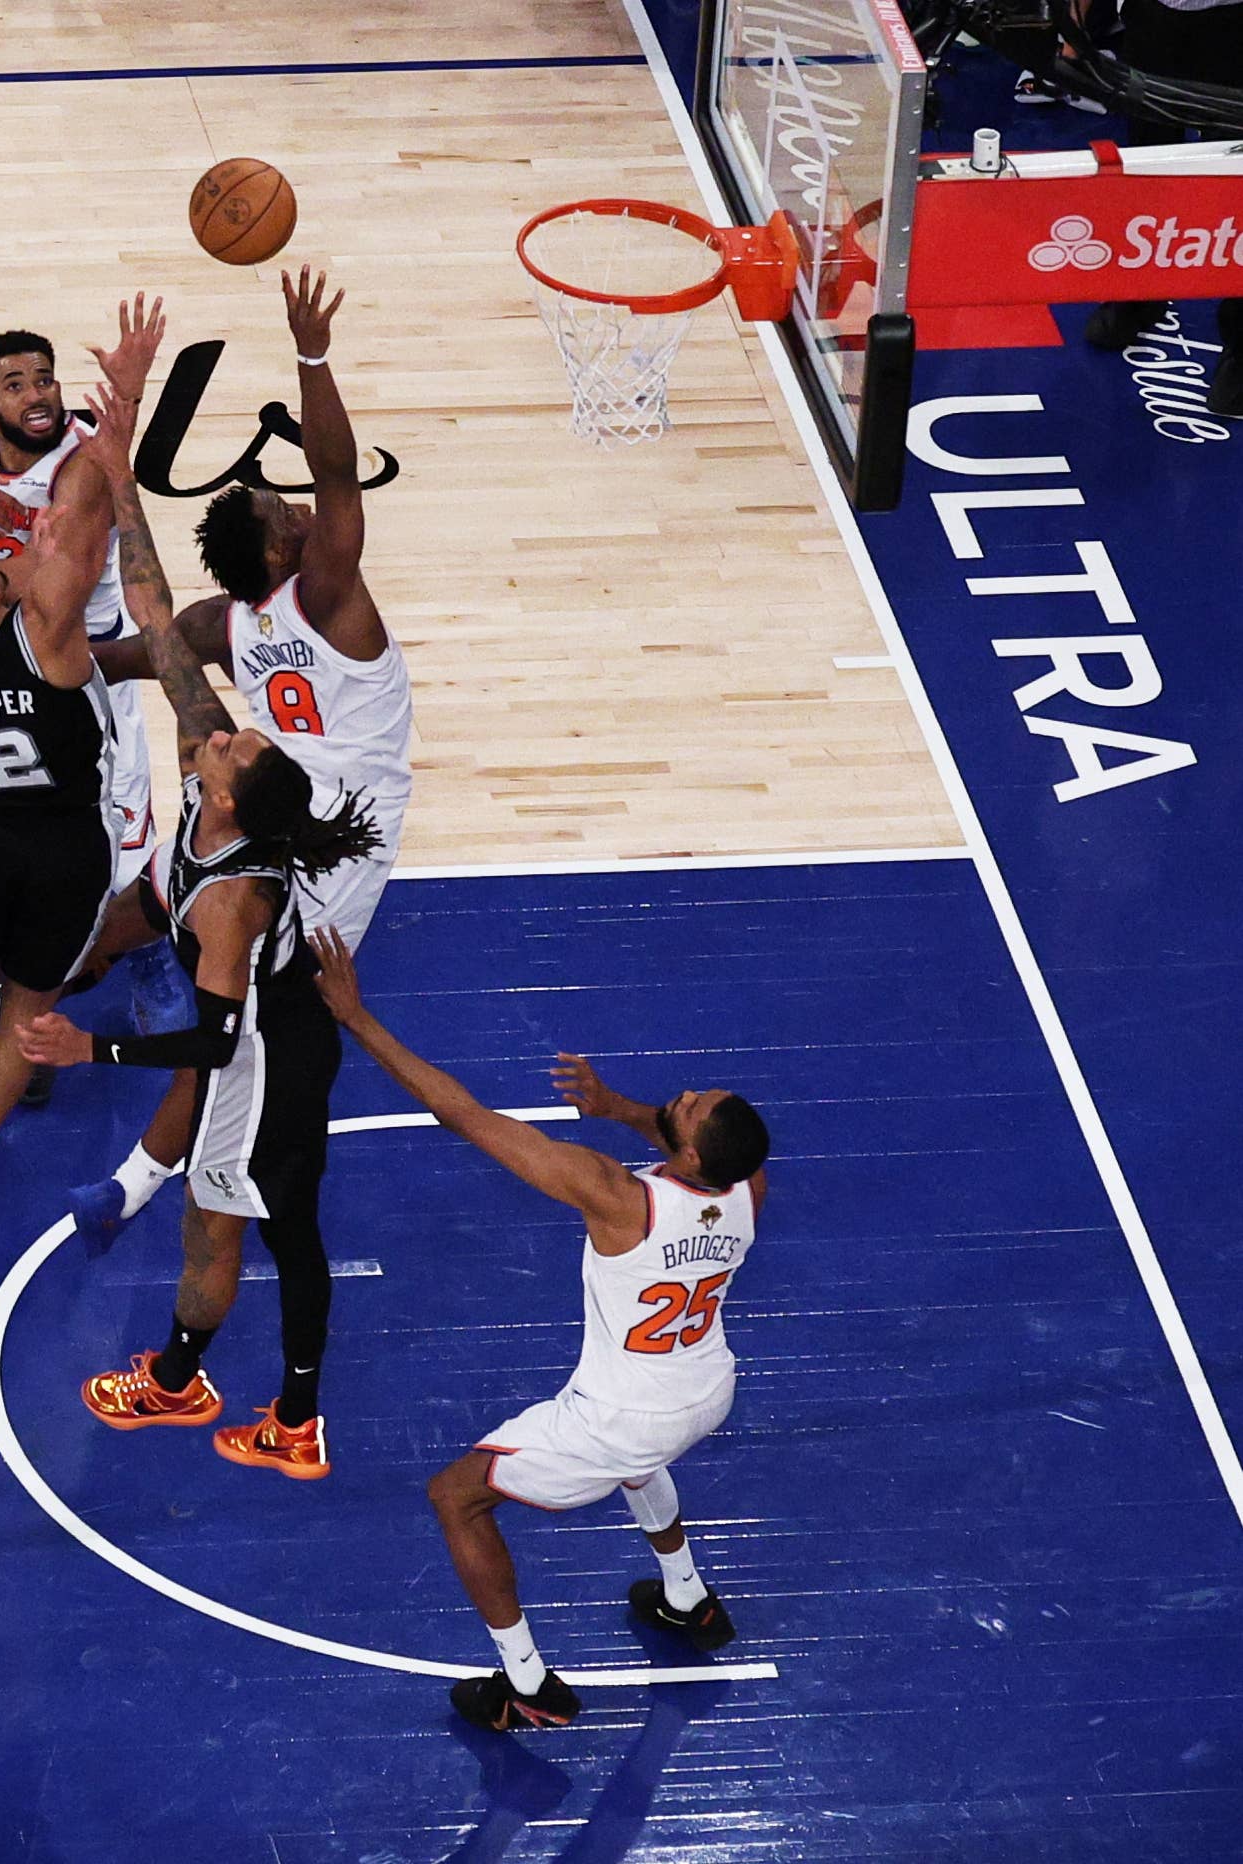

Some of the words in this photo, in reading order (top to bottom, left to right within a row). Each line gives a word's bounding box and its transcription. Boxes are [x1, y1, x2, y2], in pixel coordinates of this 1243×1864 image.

[906, 394, 1197, 803] ULTRA
[266, 670, 325, 737] 8
[661, 1234, 740, 1270] BRIDGES
[623, 1271, 731, 1354] 25
